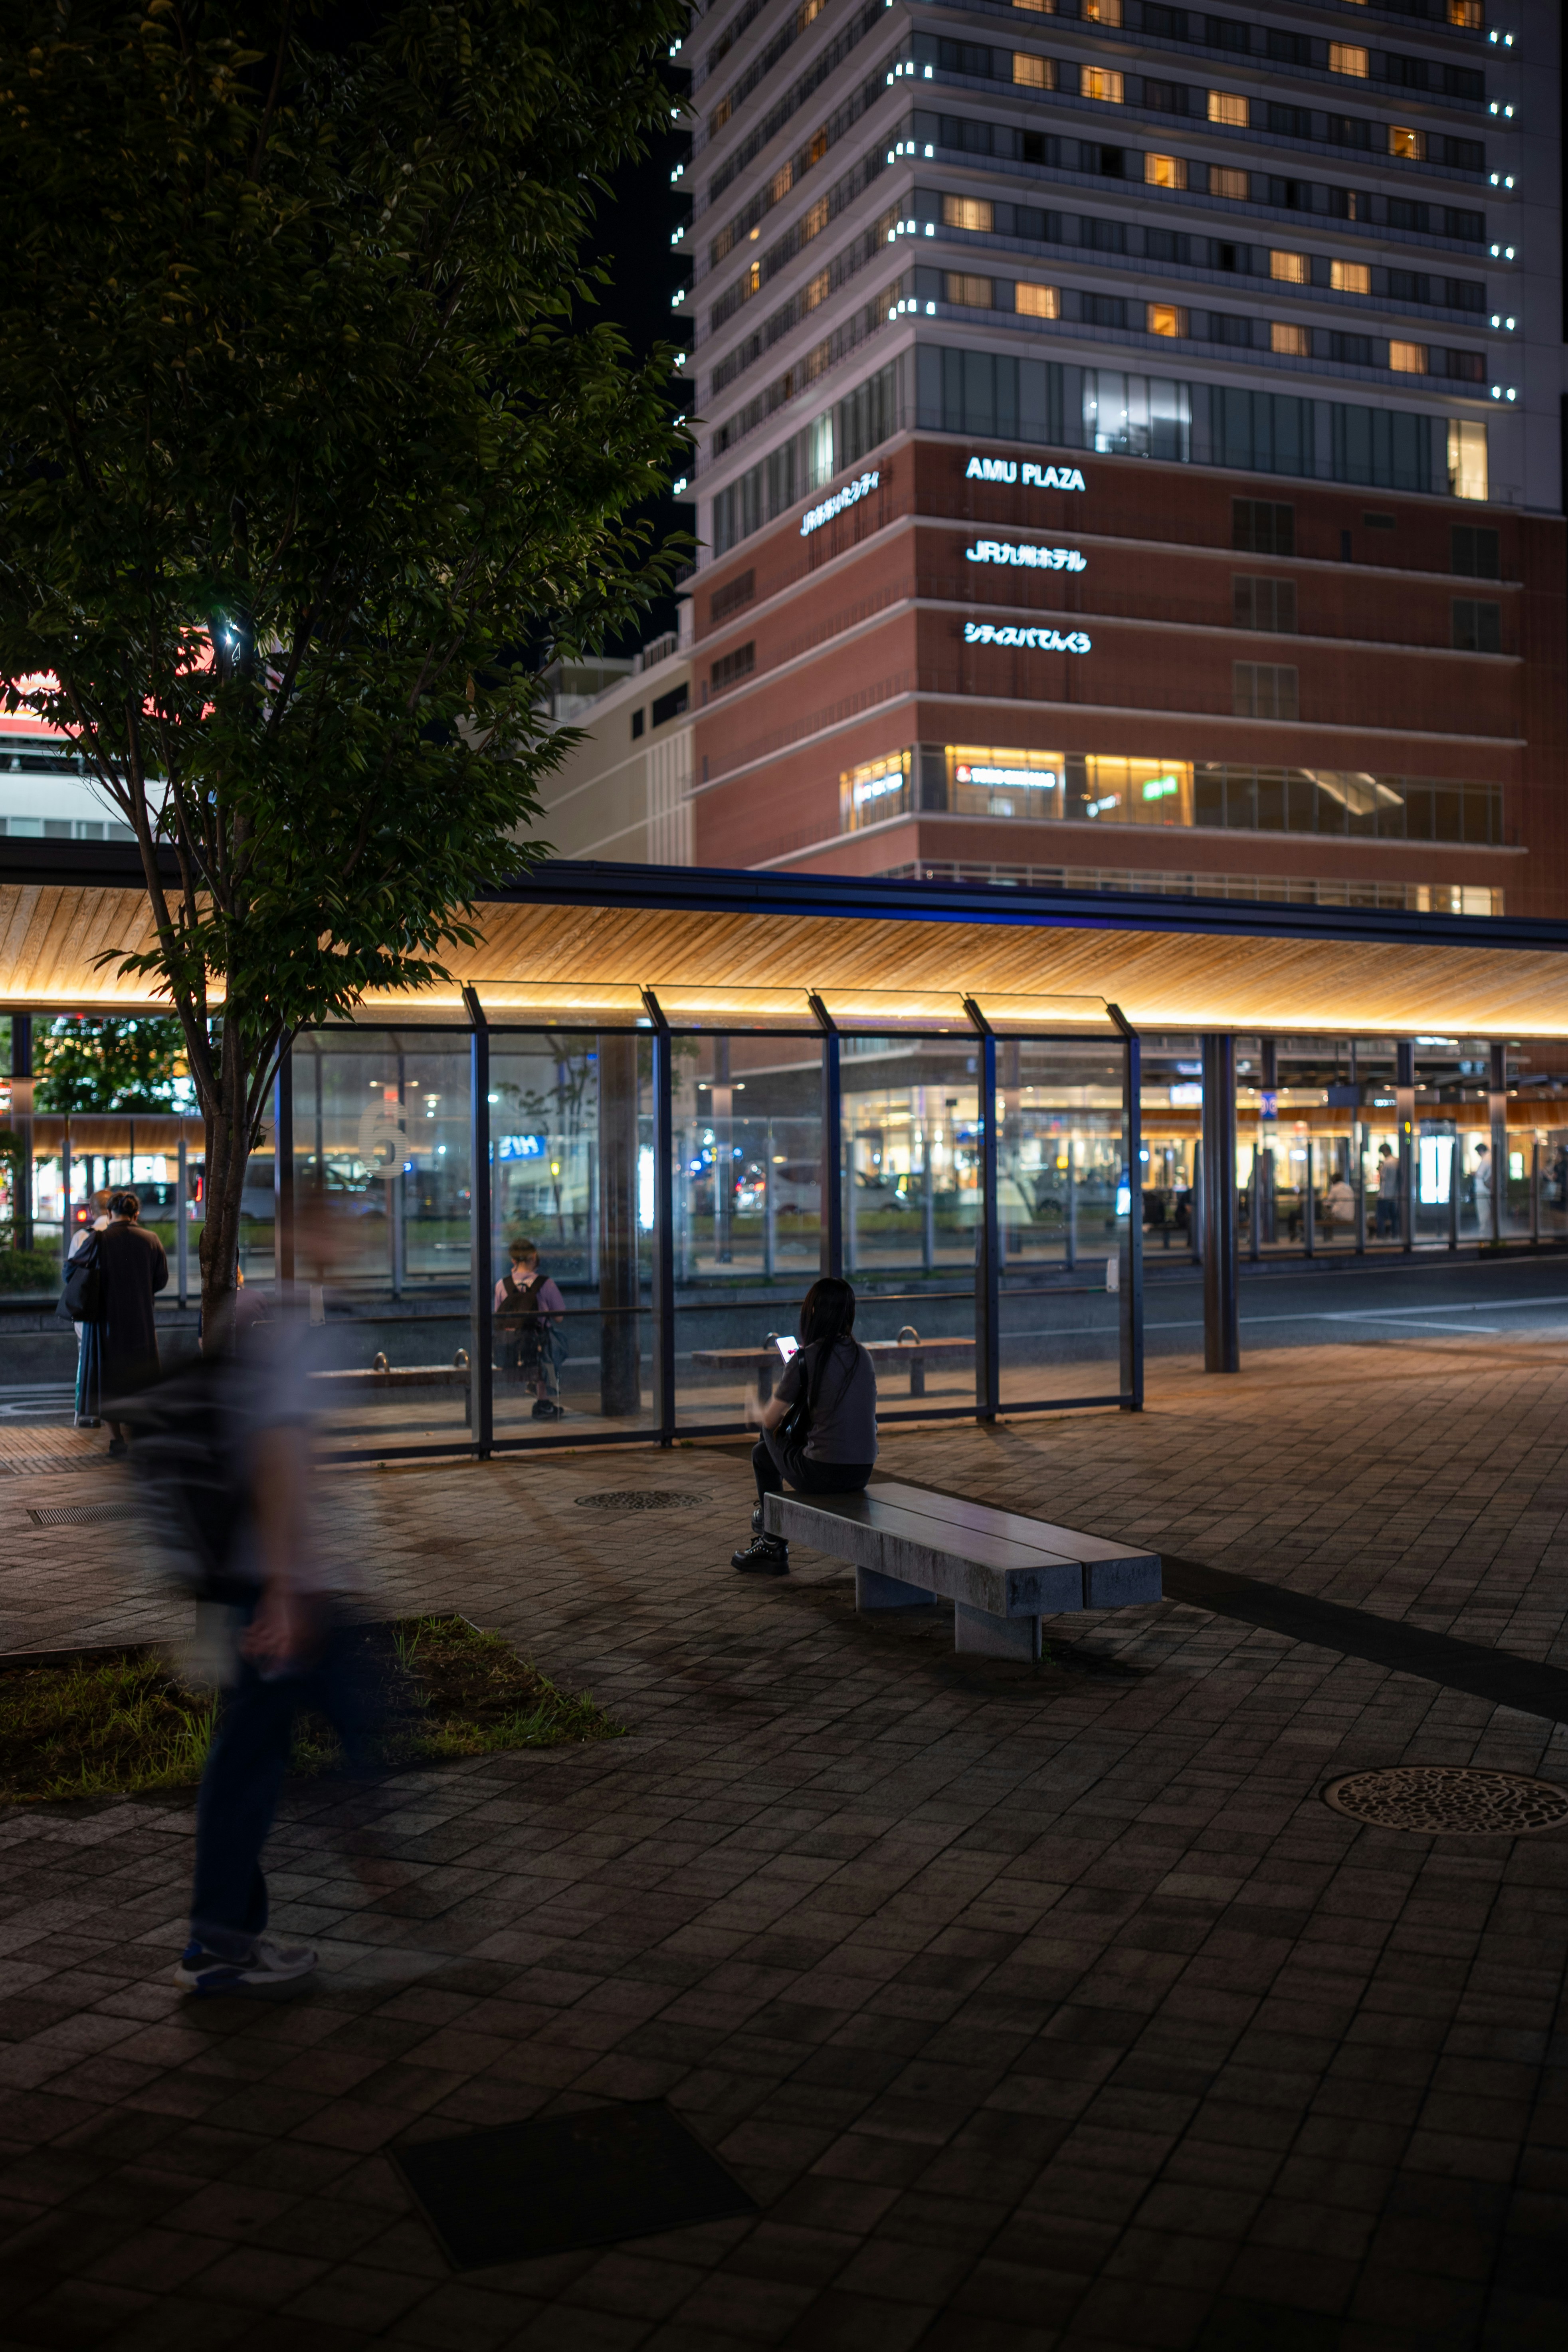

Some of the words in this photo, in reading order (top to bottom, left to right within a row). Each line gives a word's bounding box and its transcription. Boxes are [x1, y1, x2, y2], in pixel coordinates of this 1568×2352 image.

[966, 457, 1017, 484] AMU
[1022, 463, 1086, 491] PLAZA
[966, 540, 1087, 572] JR九州ホテル
[964, 622, 1092, 654] シティスパてんくう
